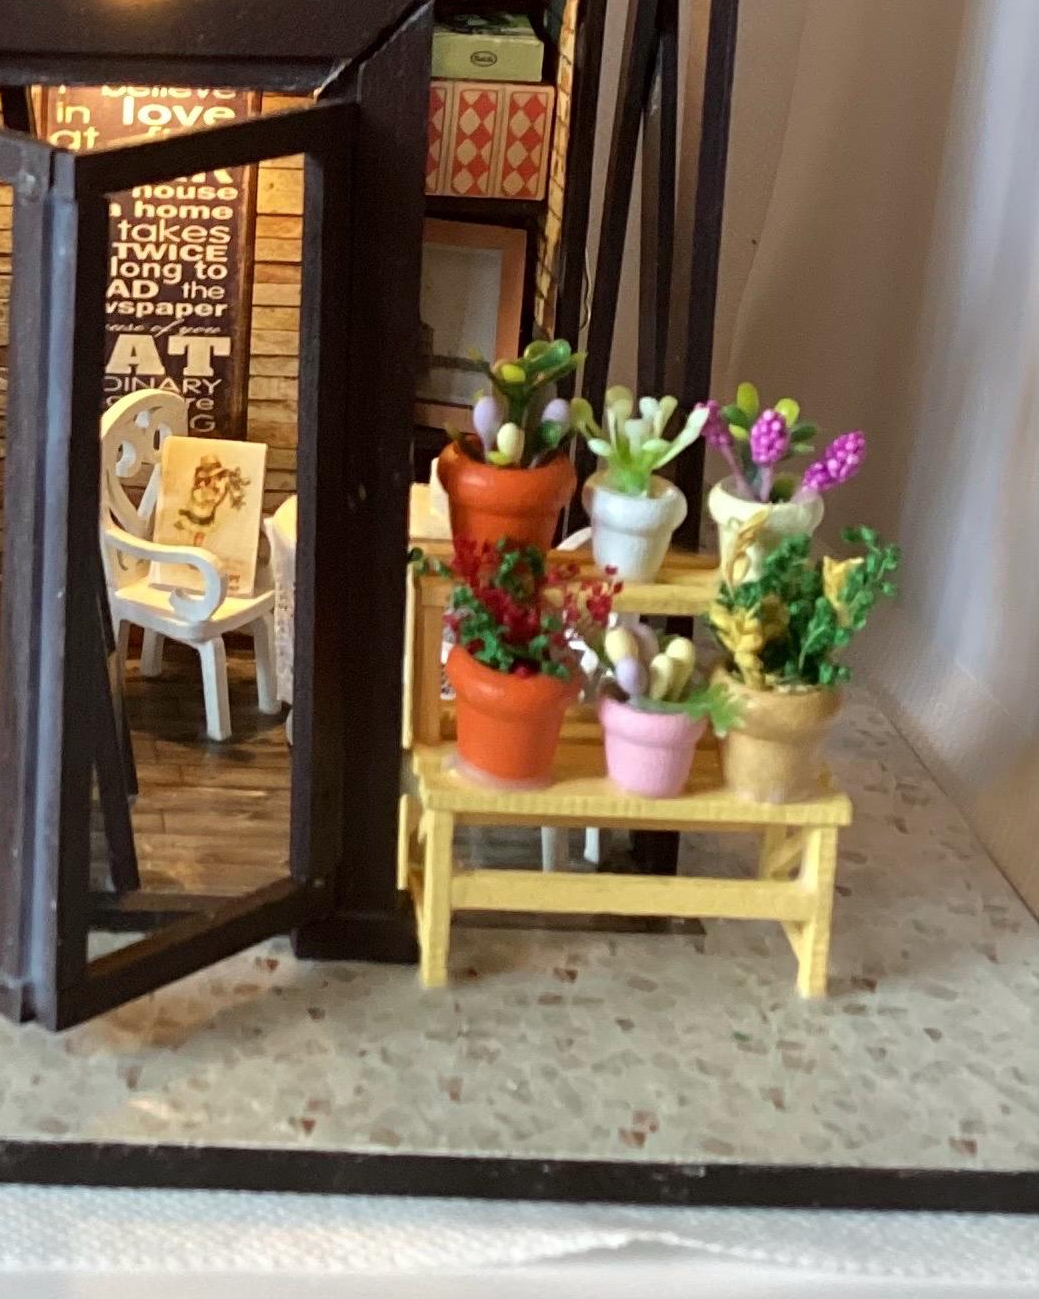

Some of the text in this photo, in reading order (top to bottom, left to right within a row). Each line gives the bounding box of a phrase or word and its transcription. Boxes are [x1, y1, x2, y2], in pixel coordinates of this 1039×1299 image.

[55, 95, 236, 127] in love
[48, 126, 100, 151] at
[133, 201, 234, 219] home
[117, 219, 231, 244] takes
[112, 242, 228, 263] TWICE
[110, 255, 228, 285] long to
[181, 280, 225, 300] the
